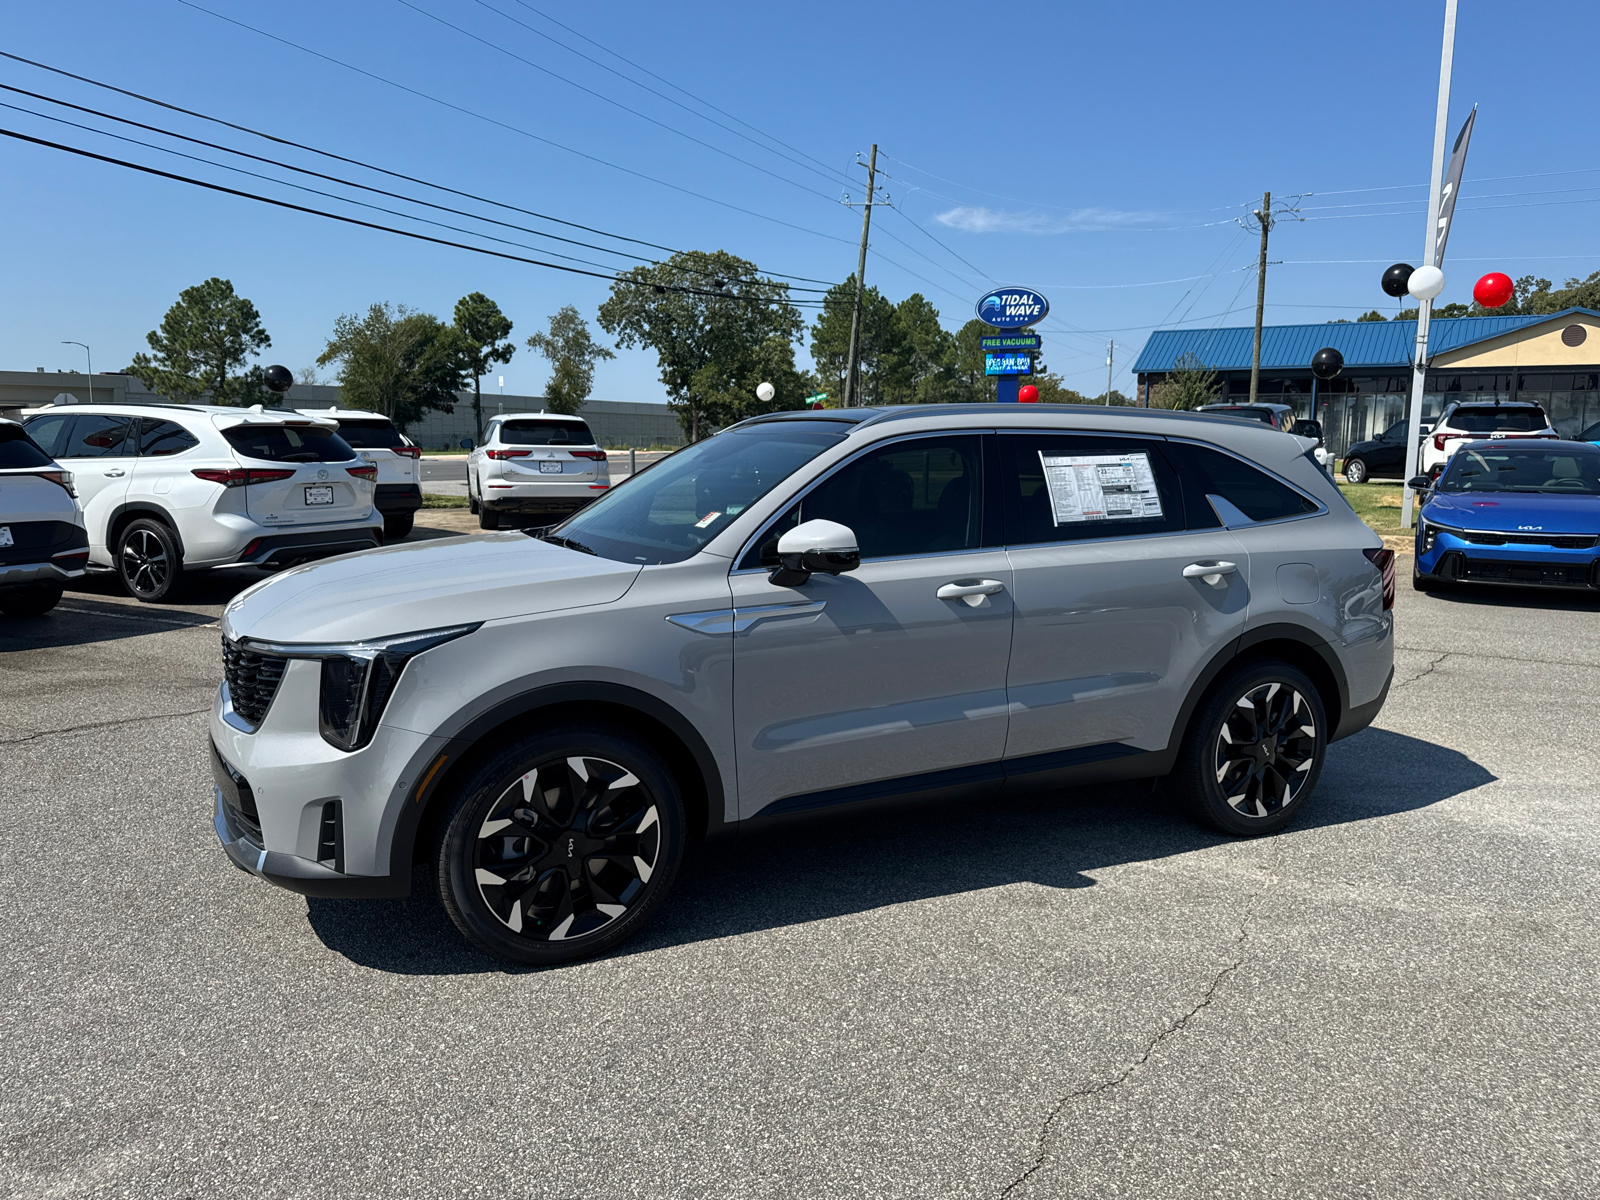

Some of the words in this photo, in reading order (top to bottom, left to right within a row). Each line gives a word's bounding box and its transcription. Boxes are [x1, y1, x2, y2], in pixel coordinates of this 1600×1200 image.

[1001, 294, 1034, 305] TIDAL
[1006, 305, 1041, 316] WAVE
[982, 338, 1001, 347] FREE
[1002, 337, 1036, 346] VACUUMS
